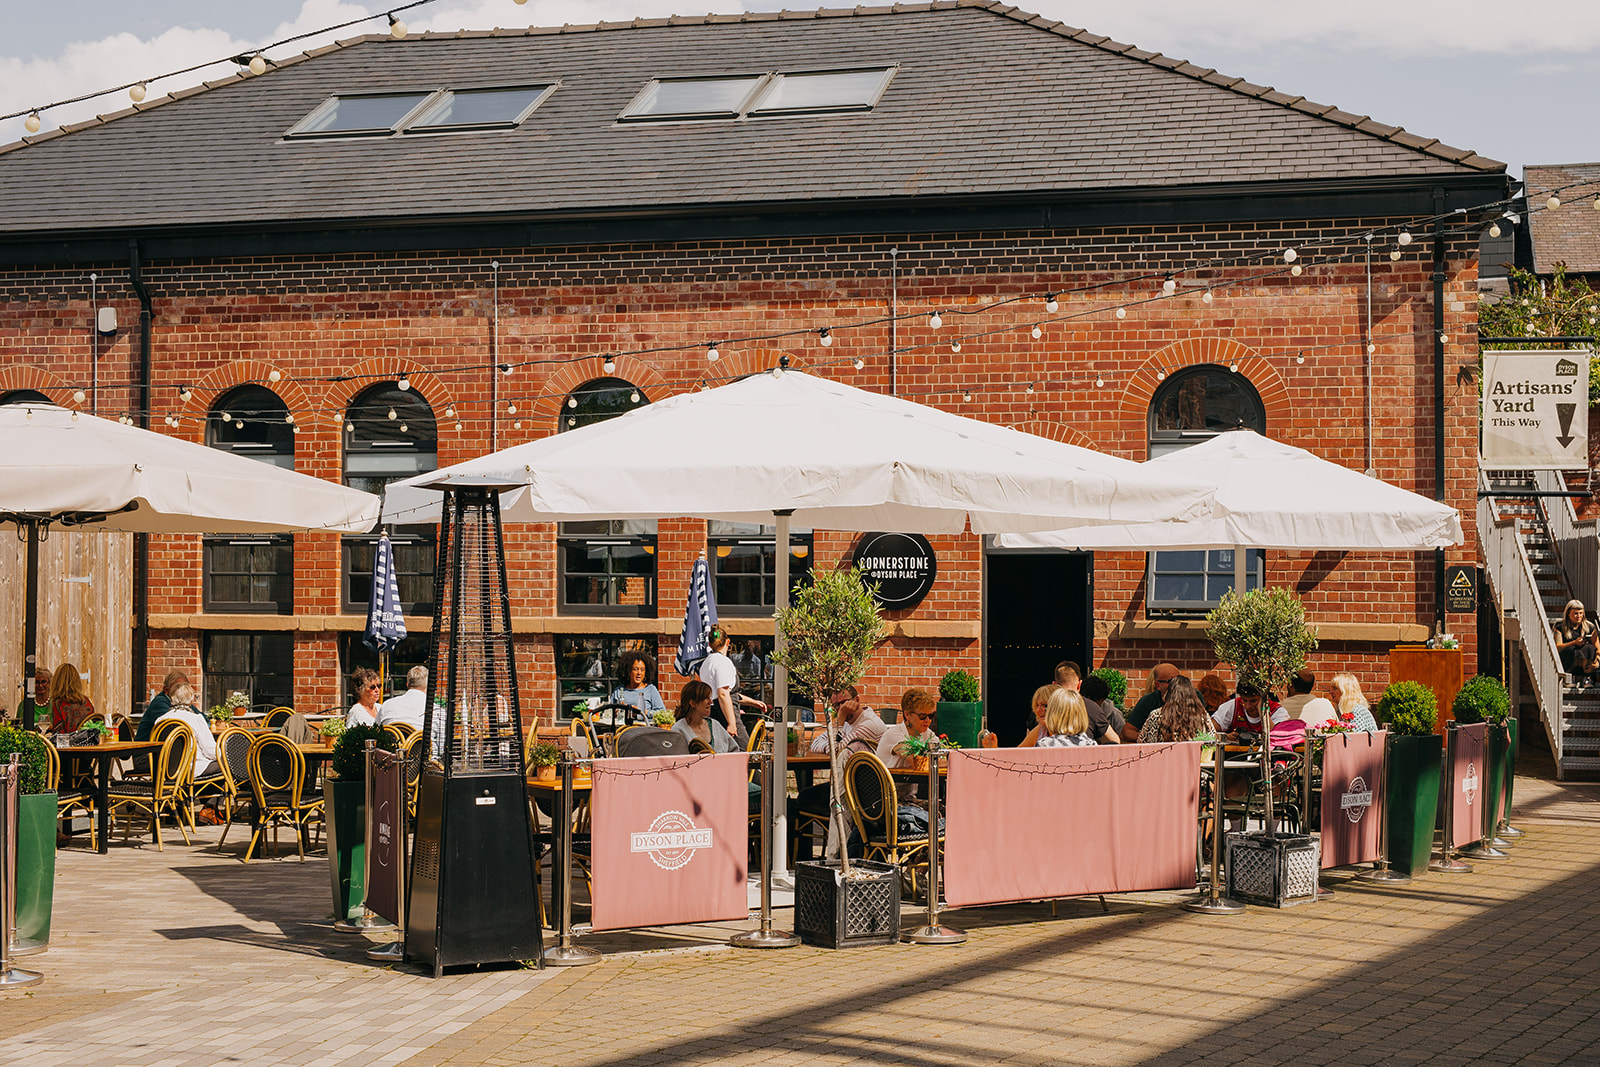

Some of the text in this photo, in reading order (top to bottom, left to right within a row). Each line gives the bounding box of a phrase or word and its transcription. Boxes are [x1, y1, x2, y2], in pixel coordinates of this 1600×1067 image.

[1492, 397, 1535, 413] Yard
[1491, 418, 1542, 429] This Way
[860, 556, 929, 570] CORNERSTONE
[870, 570, 918, 579] @DYSON PLACE
[1448, 588, 1475, 597] CCTV
[635, 832, 709, 848] DYSON PLACE
[658, 854, 688, 868] SHEFFIELD
